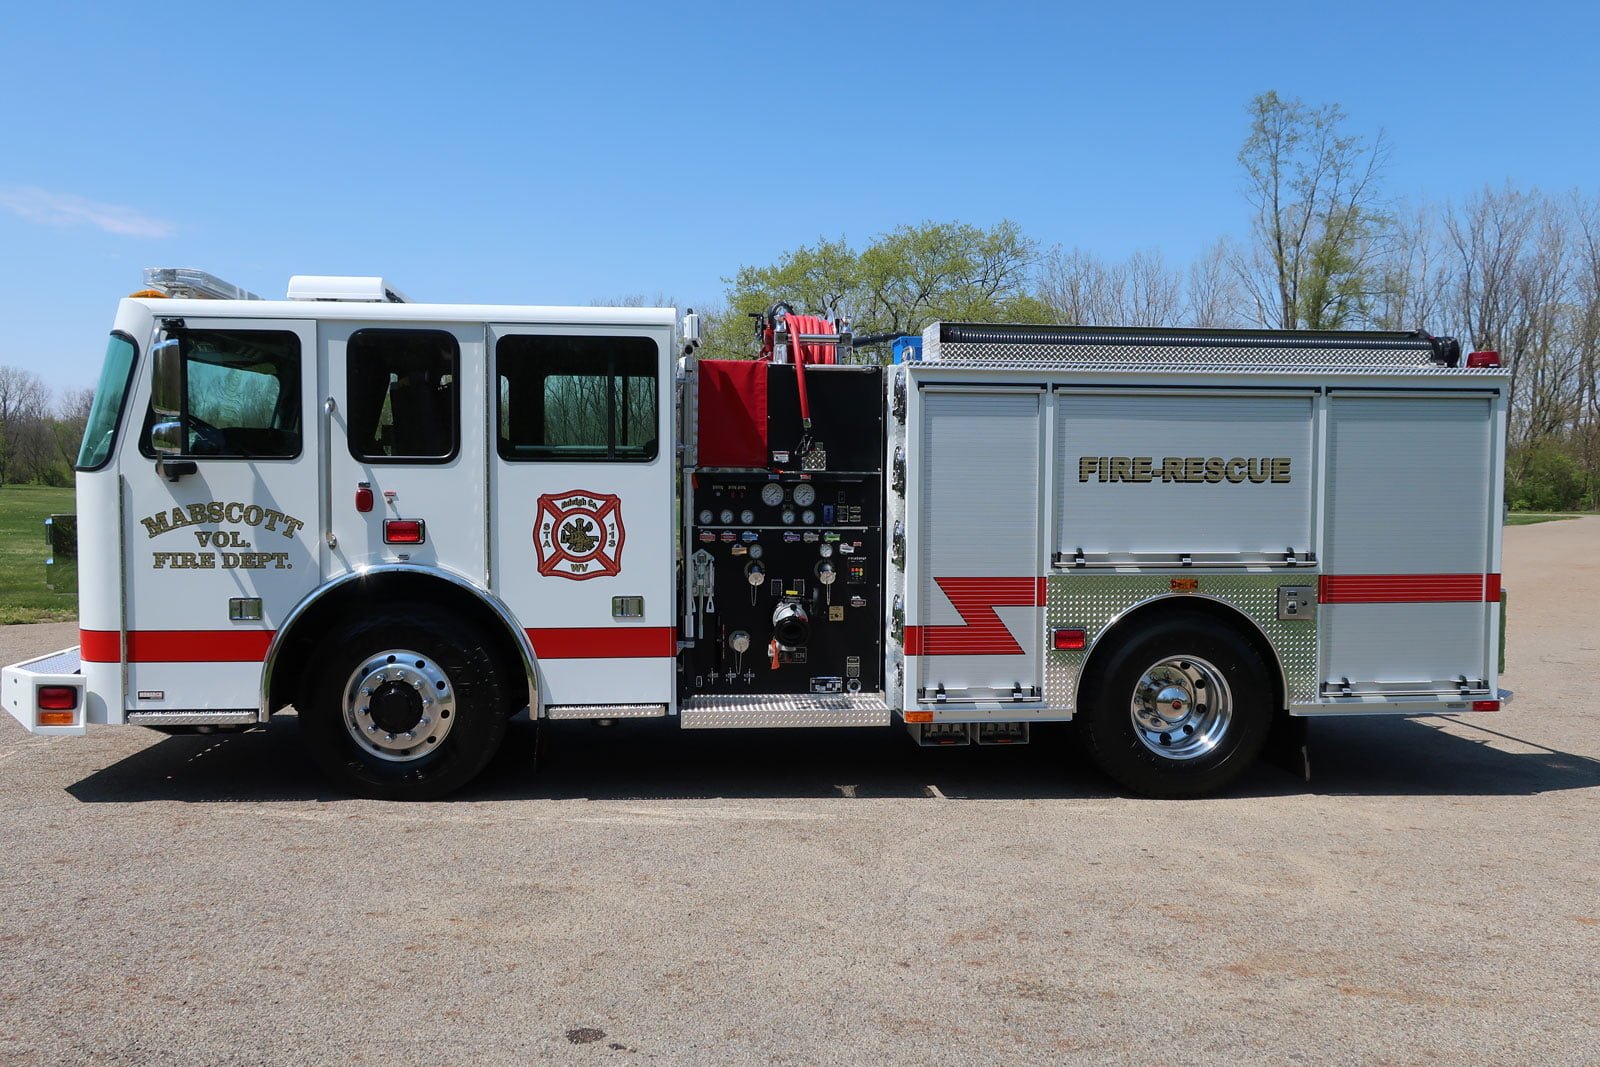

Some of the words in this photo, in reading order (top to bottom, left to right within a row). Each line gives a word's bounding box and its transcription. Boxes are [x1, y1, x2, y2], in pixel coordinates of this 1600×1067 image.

[1078, 456, 1292, 484] FIRE-RESCUE
[140, 502, 304, 539] MABSCOTT
[194, 531, 252, 548] VOL.
[153, 552, 216, 569] FIRE
[221, 552, 293, 569] DEPT.
[570, 563, 589, 573] WV
